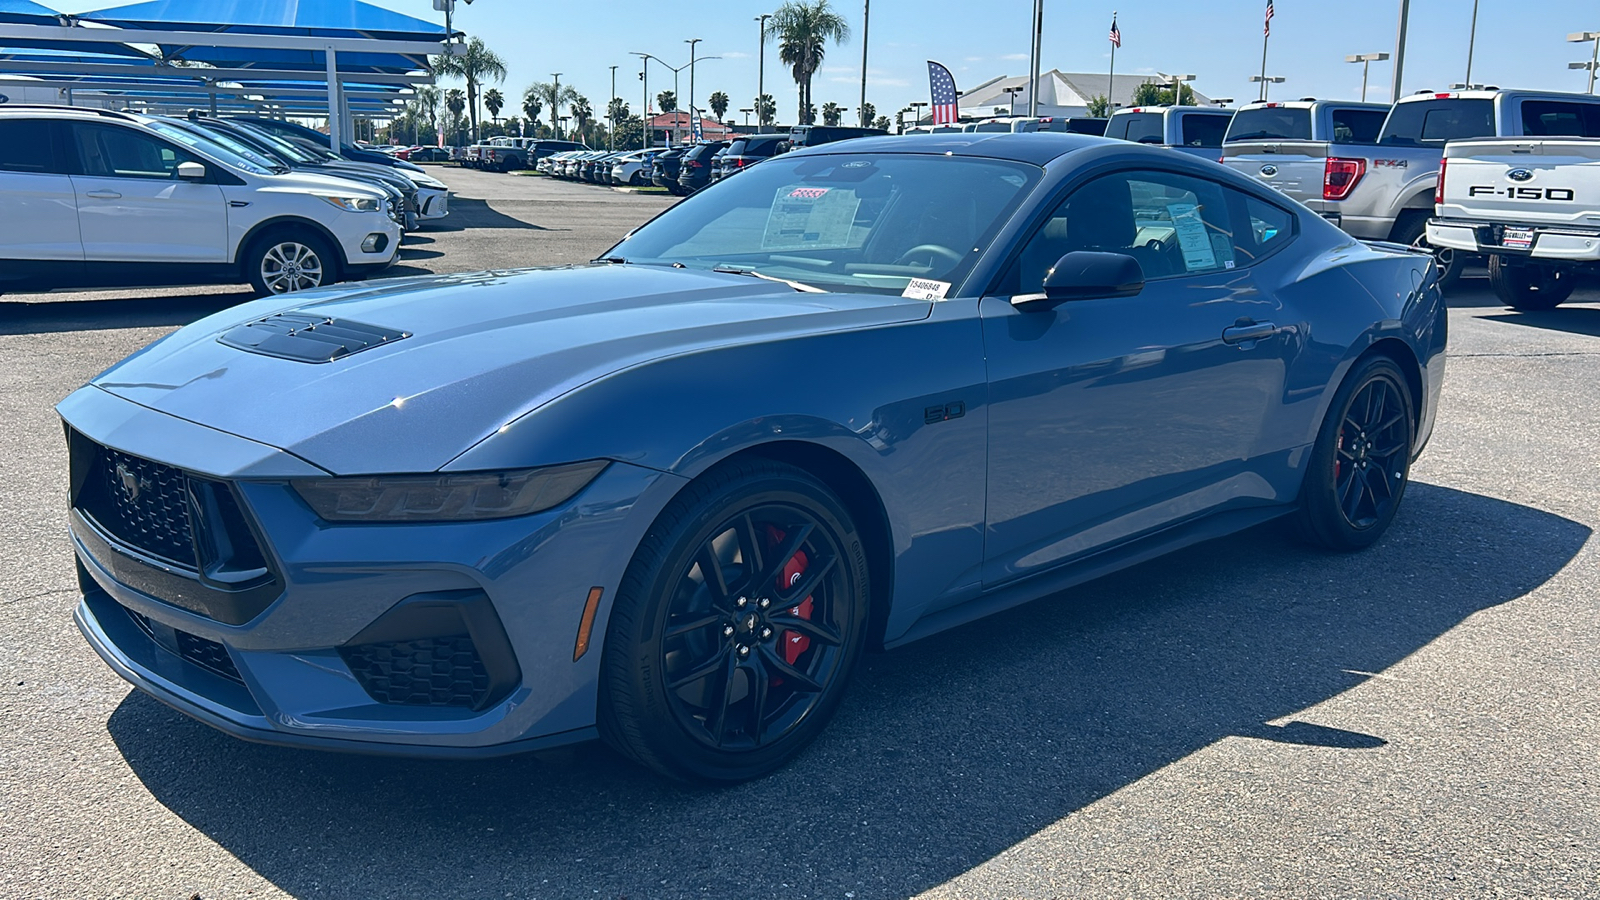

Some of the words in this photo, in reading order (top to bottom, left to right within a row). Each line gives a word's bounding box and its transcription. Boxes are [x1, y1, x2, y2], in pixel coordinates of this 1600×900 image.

[1374, 159, 1408, 168] FX4
[1469, 186, 1574, 201] F-150
[924, 400, 966, 425] 5.0
